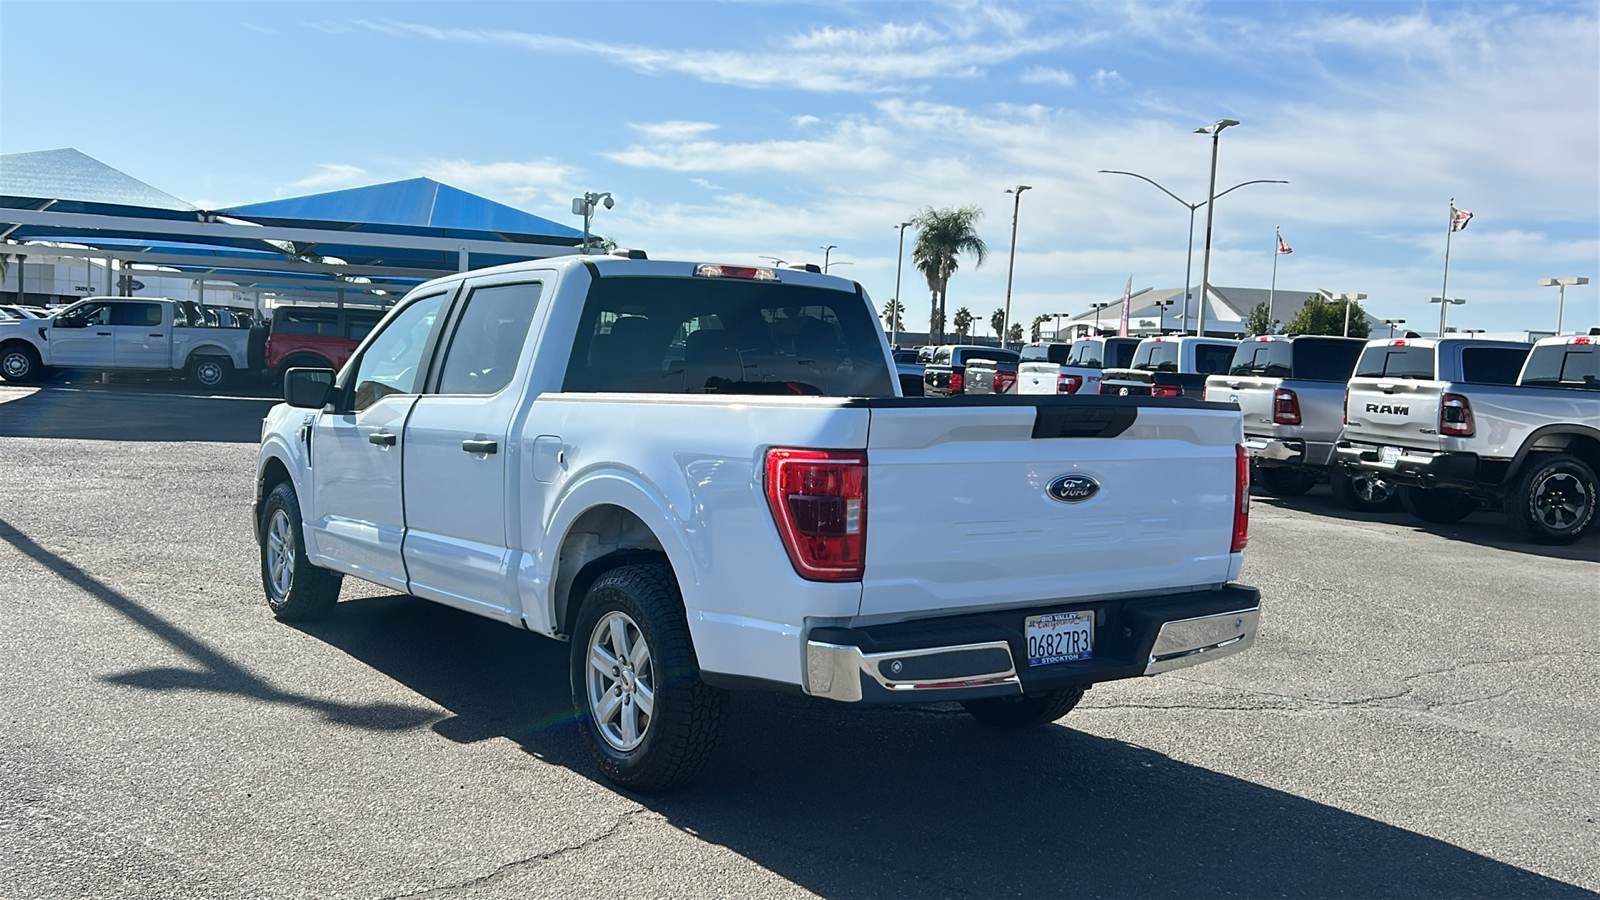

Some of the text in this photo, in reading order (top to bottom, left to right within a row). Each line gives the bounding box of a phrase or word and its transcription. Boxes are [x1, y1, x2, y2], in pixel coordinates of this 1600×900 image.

[1365, 403, 1410, 415] RAM
[1060, 479, 1091, 497] Ford
[1054, 613, 1078, 621] VALLEY
[1029, 630, 1089, 658] 06827R3
[1041, 654, 1079, 664] STOCKTON
